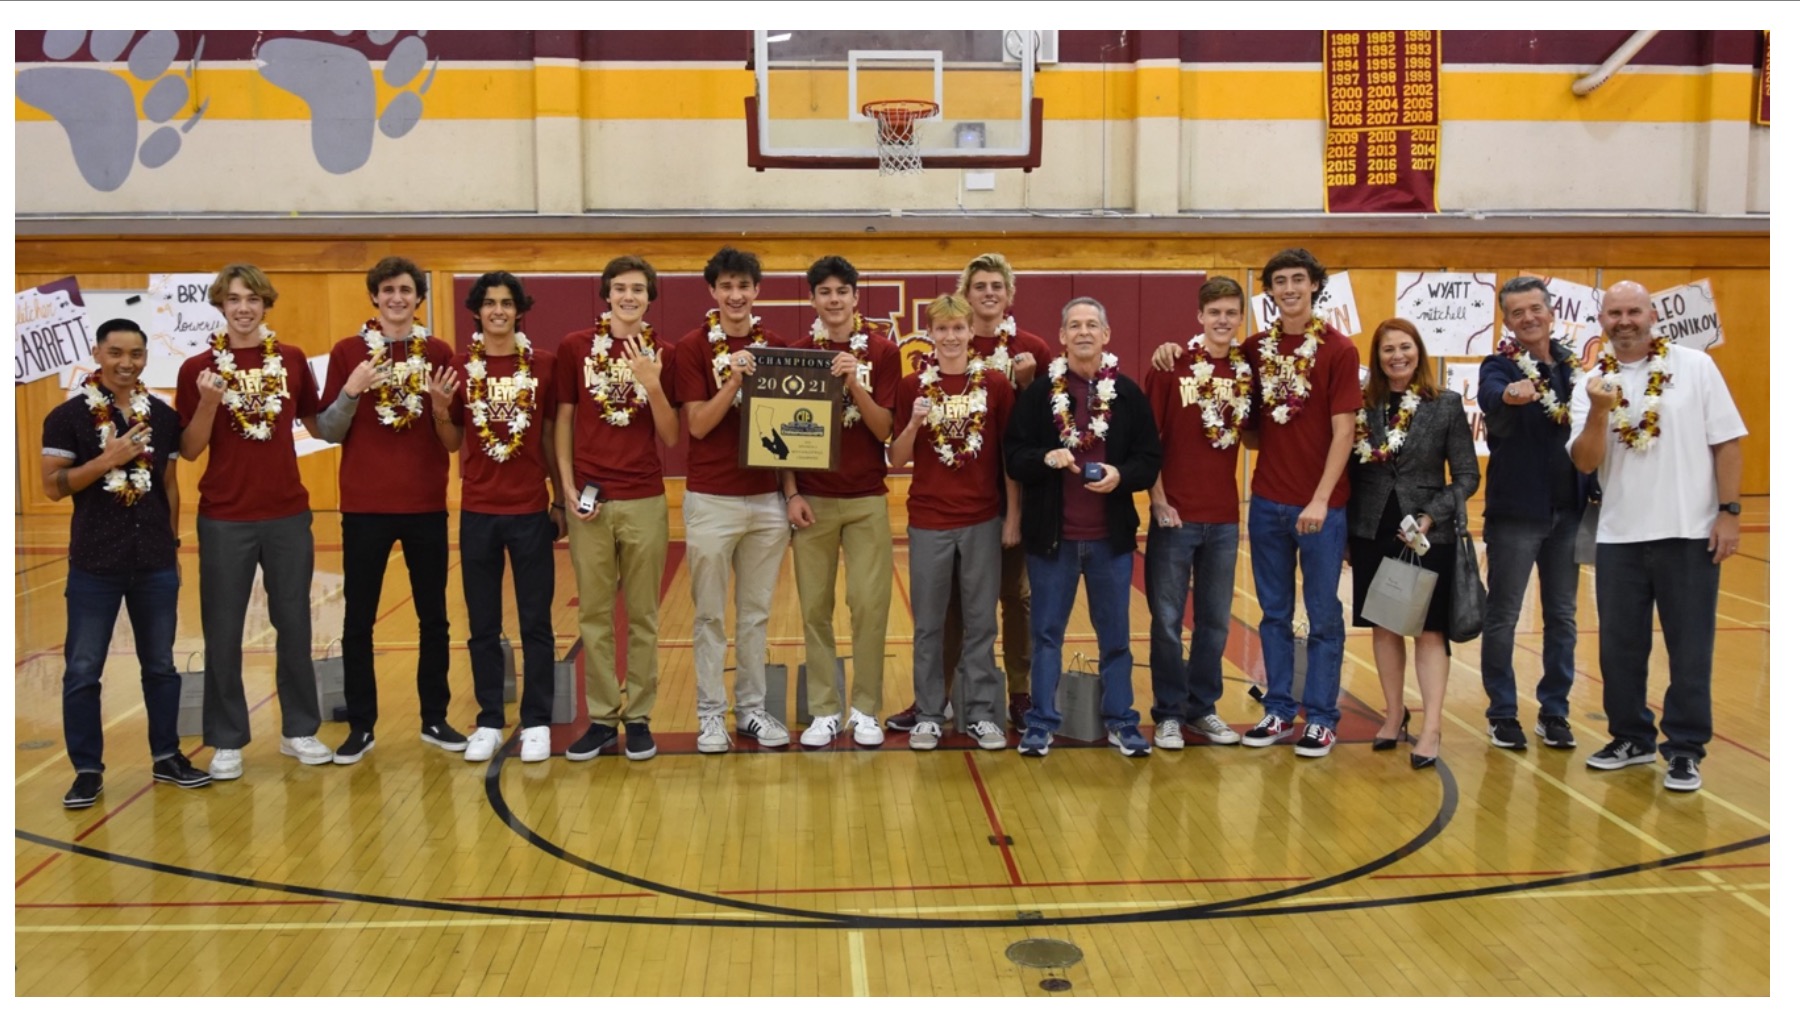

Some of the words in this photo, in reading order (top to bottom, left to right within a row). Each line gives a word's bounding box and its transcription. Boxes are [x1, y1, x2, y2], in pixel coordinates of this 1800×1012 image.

[1331, 33, 1360, 46] 1988
[1366, 31, 1395, 44] 1989
[1404, 30, 1432, 42] 1990
[1332, 46, 1359, 58] 1991
[1366, 44, 1396, 57] 1992
[1404, 43, 1432, 55] 1993
[1332, 60, 1359, 72] 1994
[1366, 58, 1396, 70] 1995
[1404, 57, 1432, 69] 1996
[1332, 73, 1360, 85] 1997
[1367, 71, 1397, 84] 1998
[1405, 70, 1432, 83] 1999
[1331, 87, 1362, 99] 2000
[1367, 85, 1397, 98] 2001
[1402, 84, 1433, 96] 2002
[1332, 100, 1362, 112] 2003
[1367, 99, 1399, 111] 2004
[1403, 97, 1433, 110] 2005
[1332, 113, 1363, 126] 2006
[1366, 112, 1399, 125] 2007
[1402, 111, 1433, 123] 2008
[1328, 132, 1359, 144] 2009
[1367, 130, 1397, 143] 2010
[1411, 129, 1436, 142] 2011
[1327, 146, 1357, 158] 2012
[1367, 145, 1397, 157] 2013
[1411, 143, 1436, 156] 2014
[1327, 159, 1357, 172] 2015
[1367, 159, 1397, 171] 2016
[1411, 158, 1436, 170] 2017
[1327, 173, 1357, 186] 2018
[1367, 172, 1397, 185] 2019
[177, 284, 209, 304] BRY
[1428, 281, 1471, 299] WYATT
[1416, 307, 1467, 321] mitchell
[1660, 312, 1718, 342] EDNIKOV
[757, 356, 831, 368] CHAMPIONS
[757, 377, 778, 391] 20
[808, 380, 826, 393] 21
